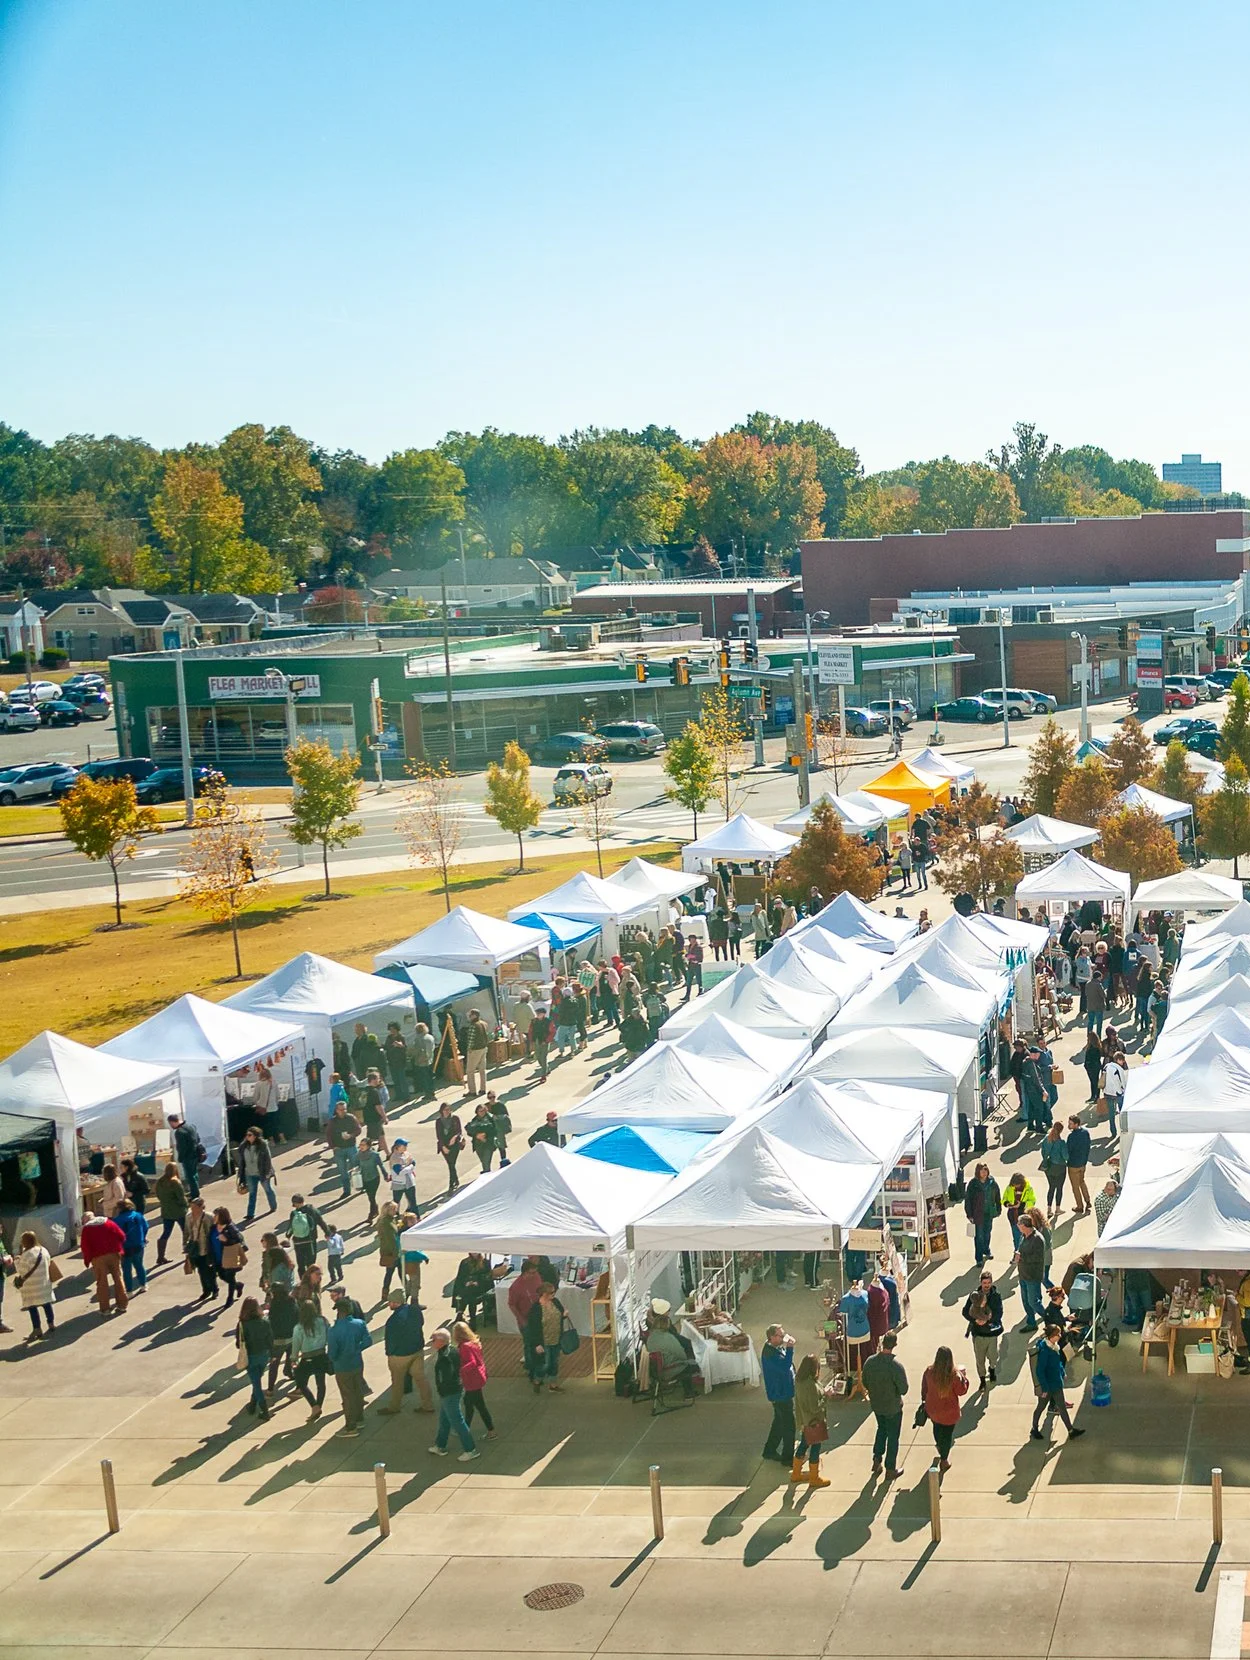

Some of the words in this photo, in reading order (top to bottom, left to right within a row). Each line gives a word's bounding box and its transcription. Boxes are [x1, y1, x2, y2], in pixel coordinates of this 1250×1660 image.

[210, 678, 236, 691] FLEA
[240, 678, 284, 691] MARKET
[731, 688, 750, 697] Autumn
[751, 688, 761, 697] Ave
